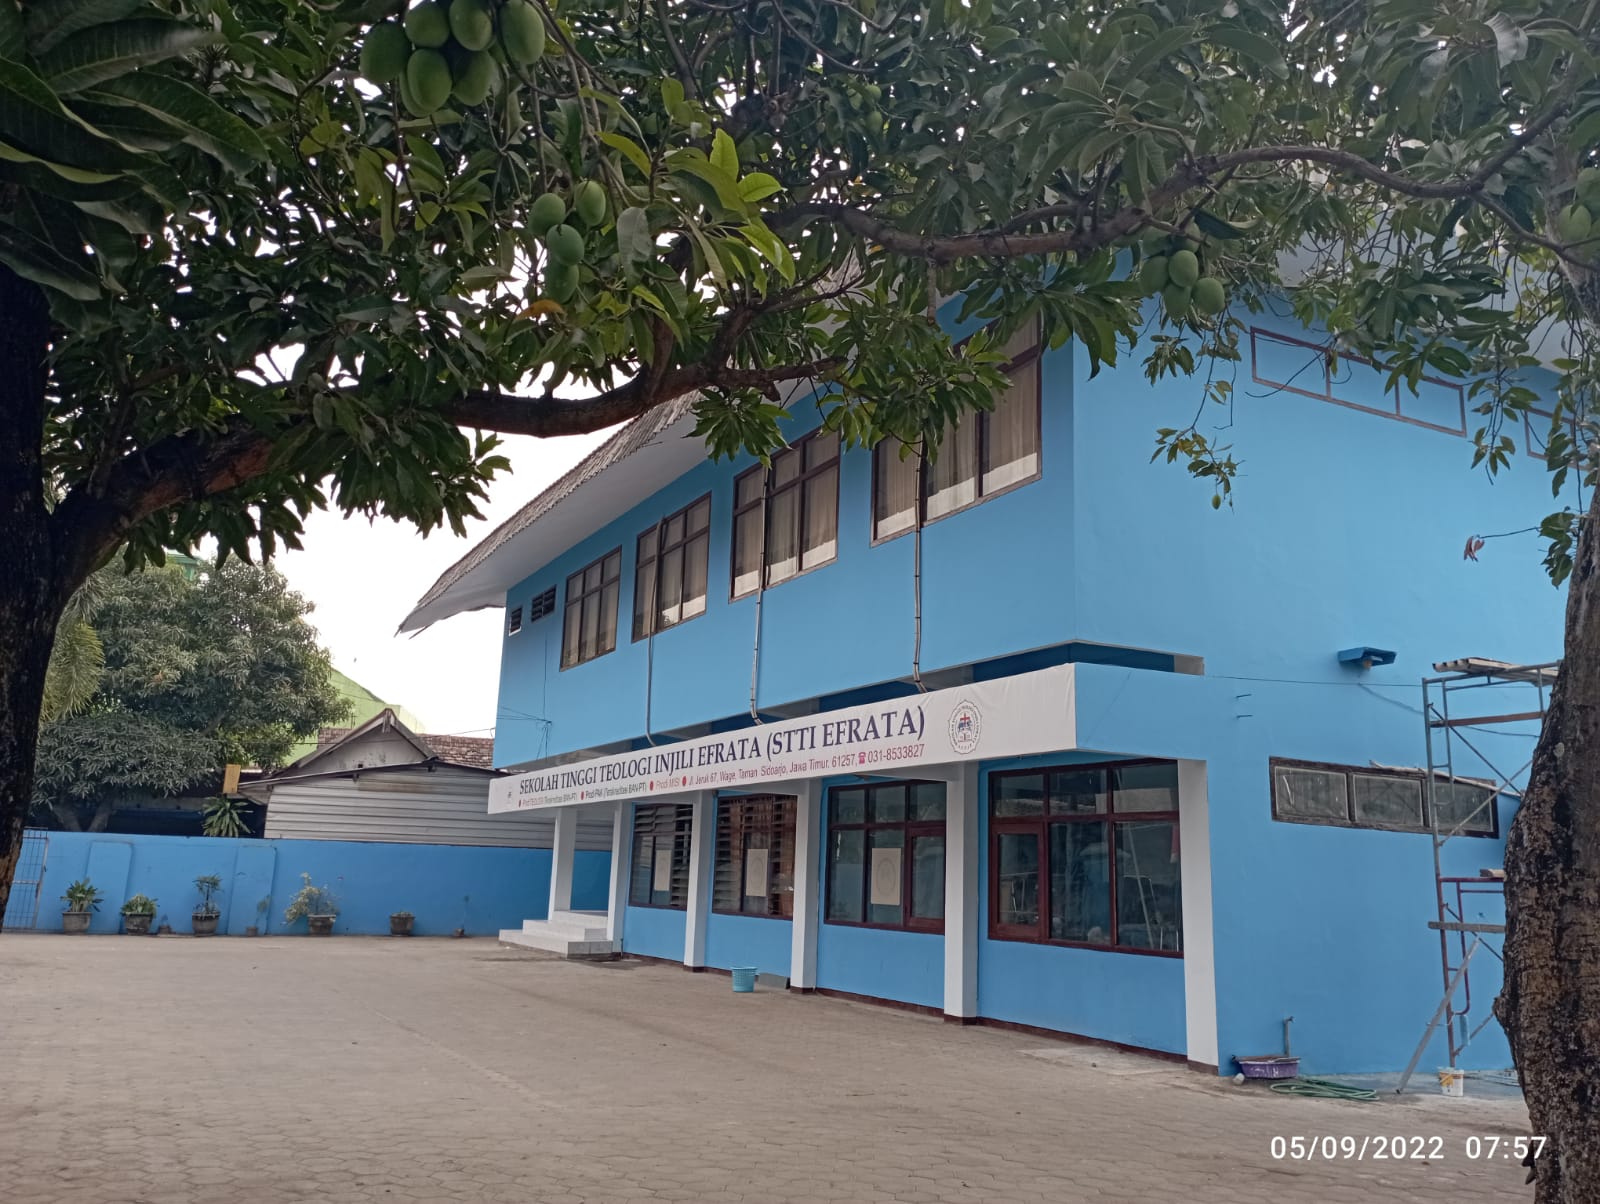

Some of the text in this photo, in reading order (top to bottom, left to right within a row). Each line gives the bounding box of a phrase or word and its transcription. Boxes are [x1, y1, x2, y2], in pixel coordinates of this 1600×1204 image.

[519, 773, 559, 795] SEKOLAH
[560, 766, 598, 789] TINGGI
[600, 755, 653, 783] TEOLOGI
[655, 747, 694, 776] INJILI
[698, 736, 761, 767] EFRATA
[766, 725, 816, 762] (STTI
[822, 705, 925, 748] EFRATA)
[739, 768, 758, 779] Taman
[789, 761, 807, 773] Jawa
[868, 743, 925, 765] 031-8533827
